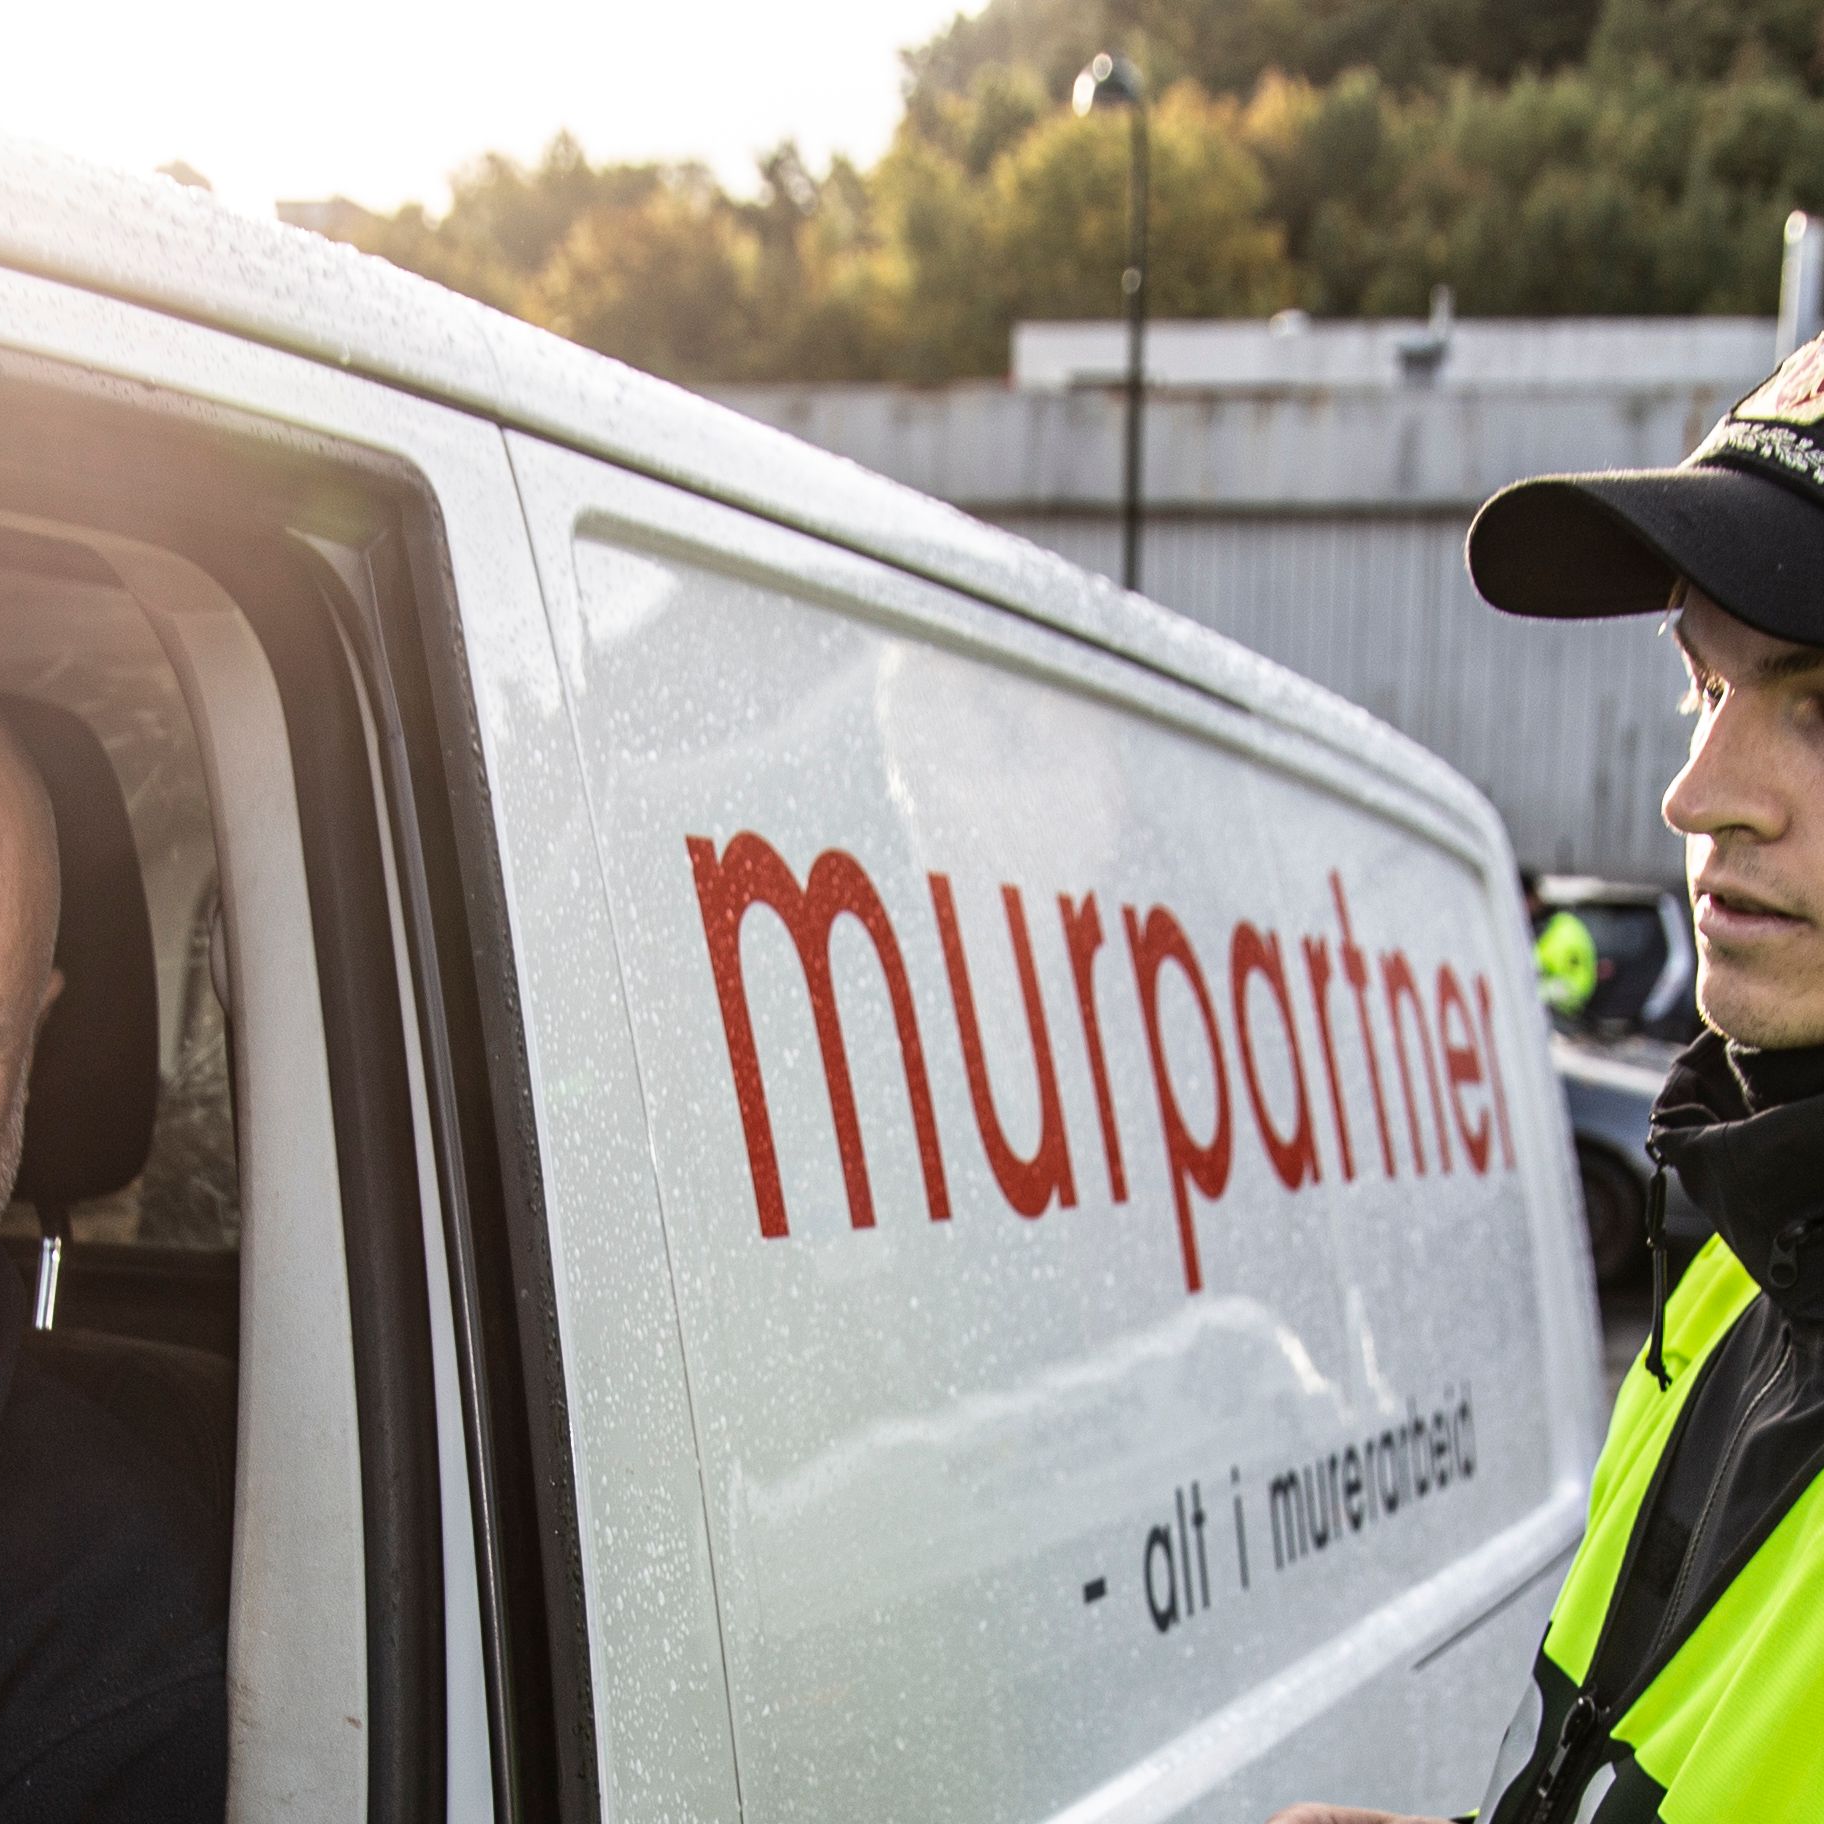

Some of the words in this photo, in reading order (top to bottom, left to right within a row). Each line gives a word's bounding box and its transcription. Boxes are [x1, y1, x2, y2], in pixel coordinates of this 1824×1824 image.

[685, 829, 1517, 1293] murpartner
[1143, 1480, 1210, 1632] alt
[1230, 1463, 1250, 1591] i
[1268, 1378, 1474, 1571] murerarbeid
